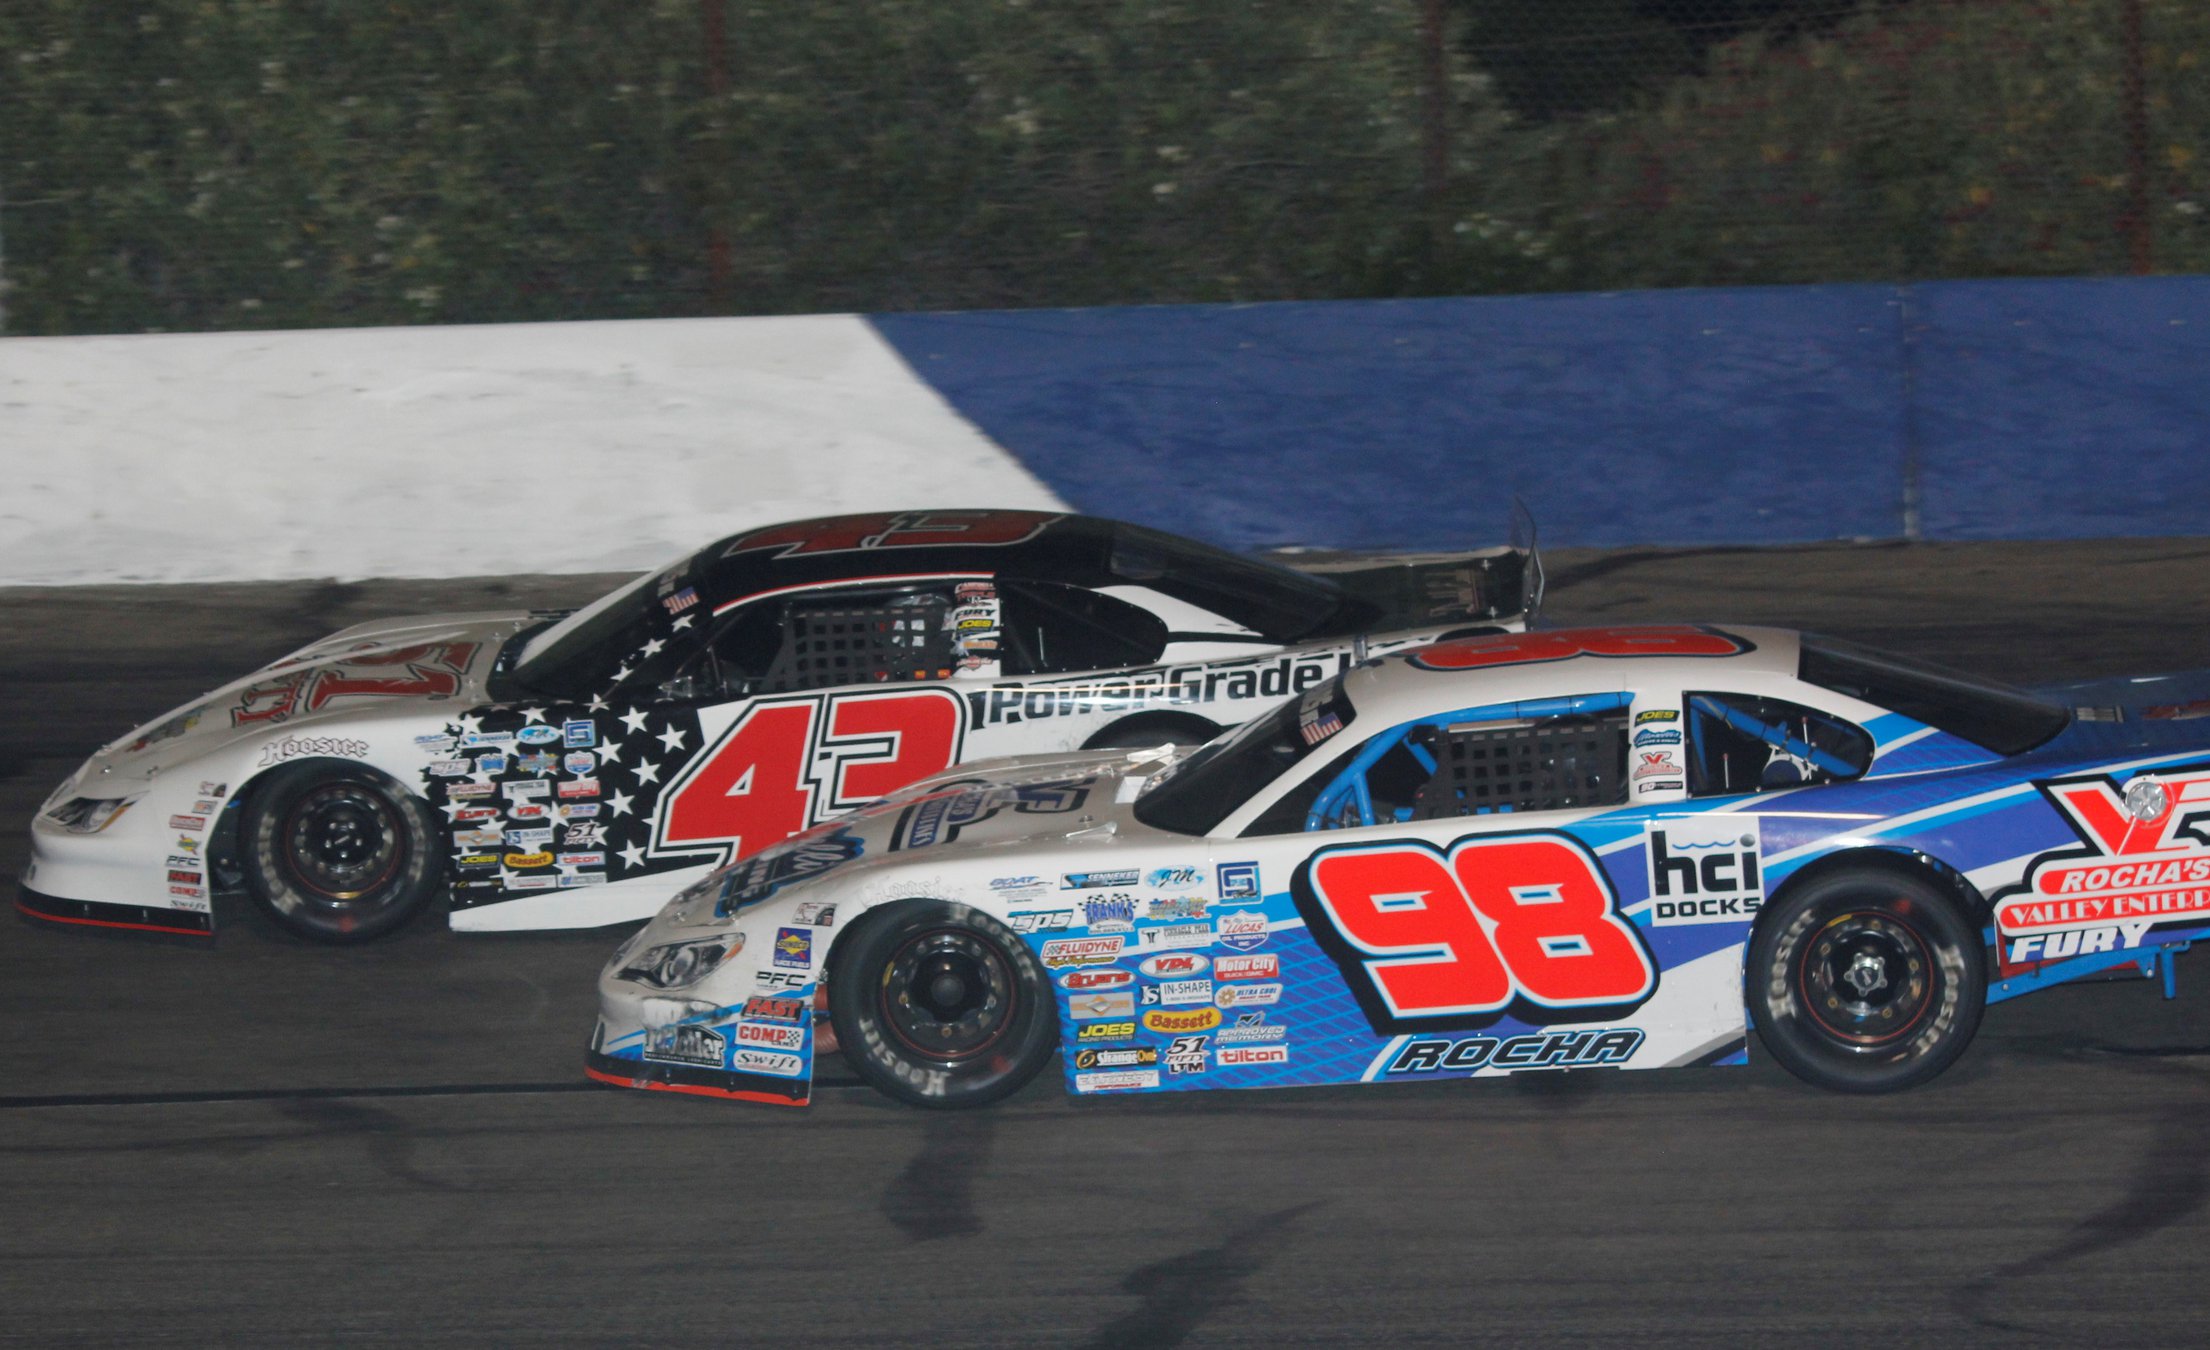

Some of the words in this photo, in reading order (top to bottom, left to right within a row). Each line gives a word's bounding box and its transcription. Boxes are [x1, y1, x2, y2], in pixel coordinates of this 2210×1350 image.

[959, 620, 993, 629] JOES
[1636, 711, 1675, 722] JOES
[259, 734, 369, 767] Hoosier
[650, 686, 968, 873] 43
[564, 824, 595, 838] 51
[167, 855, 200, 866] PFC
[1654, 830, 1758, 896] hci
[2060, 858, 2210, 894] ROCHA'S
[1656, 895, 1762, 919] DOCKS
[2009, 897, 2108, 926] VALLEY
[1225, 922, 1264, 934] LUCAS
[1305, 831, 1655, 1022] 98
[1060, 940, 1118, 955] FLUIDYNE
[2009, 923, 2155, 964] FURY
[1217, 959, 1251, 972] Motor
[1252, 957, 1275, 973] City
[756, 971, 806, 987] PFC
[1163, 981, 1211, 995] IN-SHAPE
[746, 997, 801, 1017] FAST
[1151, 1011, 1213, 1029] Bassett
[738, 1025, 788, 1043] COMP
[1078, 1022, 1136, 1038] JOES
[1166, 1035, 1207, 1054] 51
[1387, 1029, 1643, 1074] ROCHA
[737, 1052, 798, 1070] Swift
[1221, 1050, 1283, 1063] tilton
[1170, 1062, 1204, 1073] LTM
